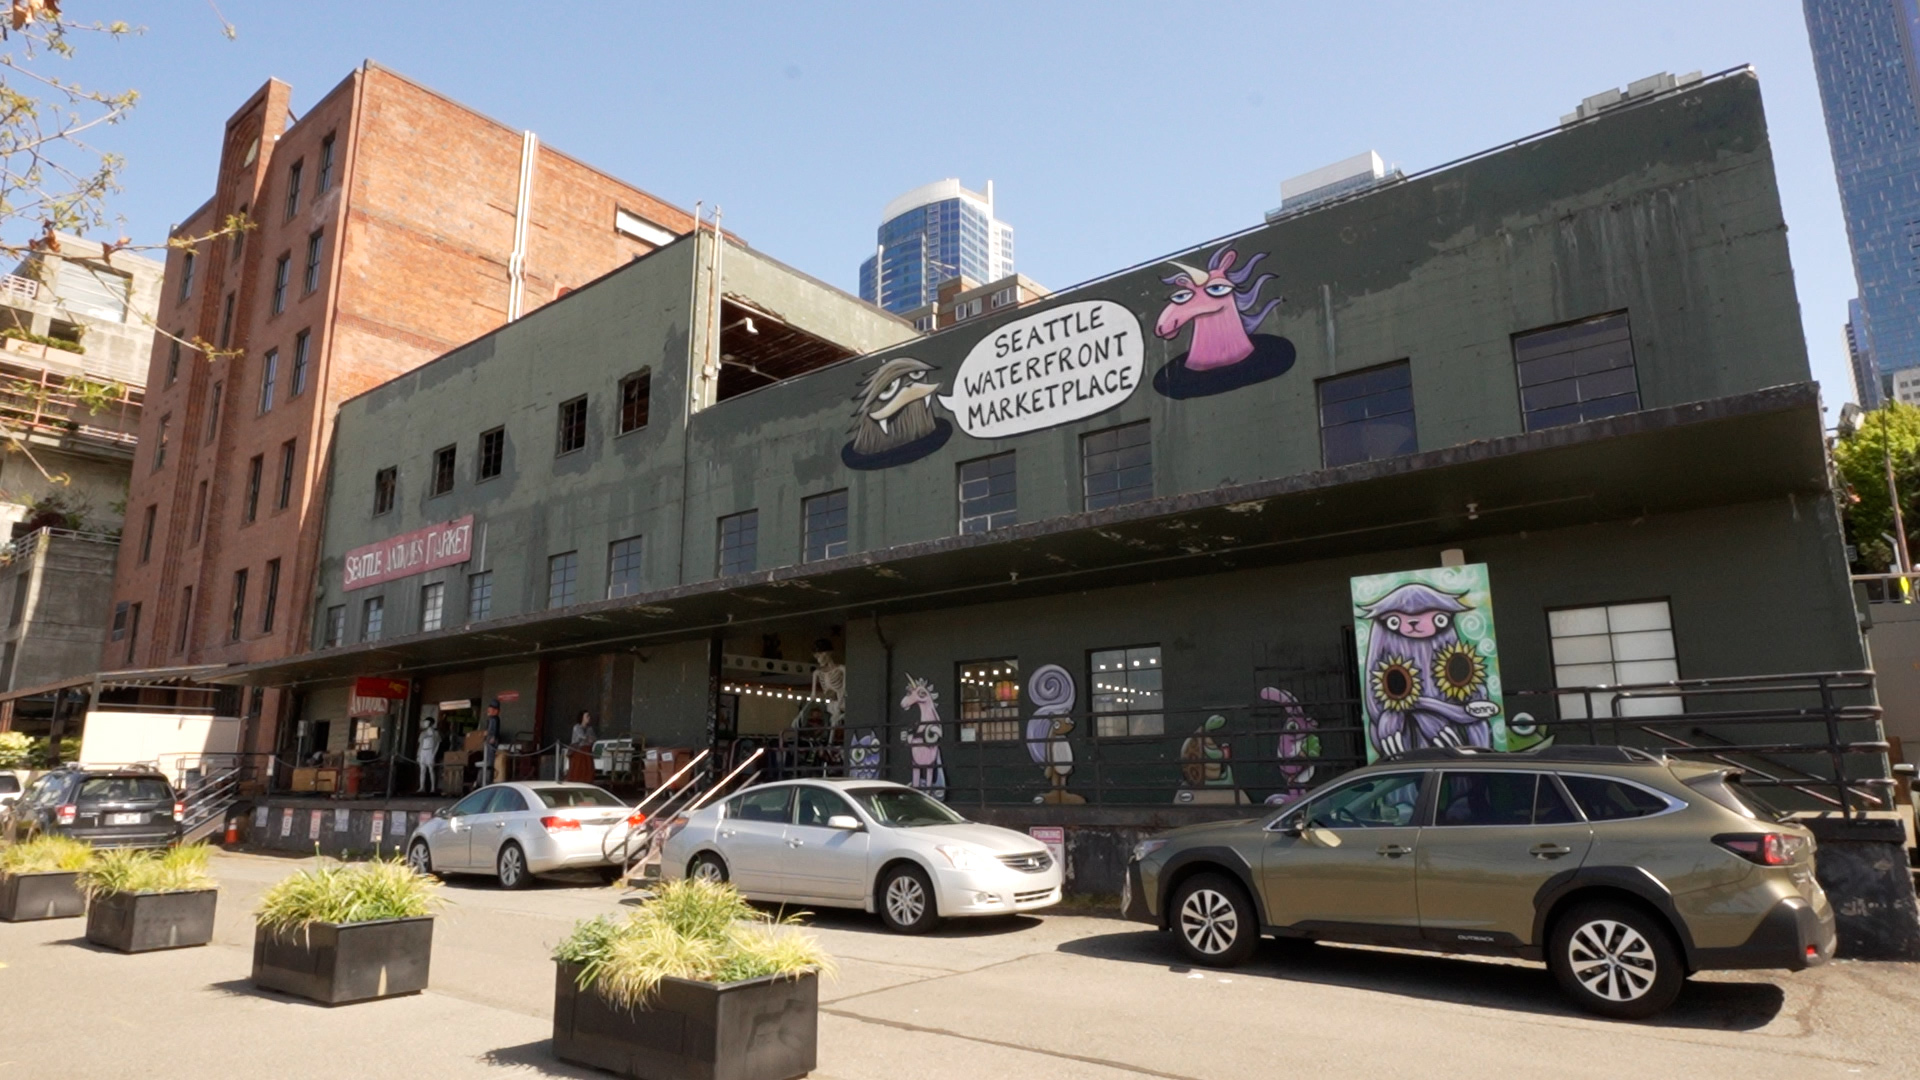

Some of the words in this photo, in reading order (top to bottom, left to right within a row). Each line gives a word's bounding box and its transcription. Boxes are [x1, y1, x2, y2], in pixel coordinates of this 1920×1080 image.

[994, 306, 1105, 359] SEATTLE
[964, 331, 1128, 398] WATERFRONT
[967, 366, 1133, 430] MARKETPLACE
[345, 551, 383, 584] SEATTLE
